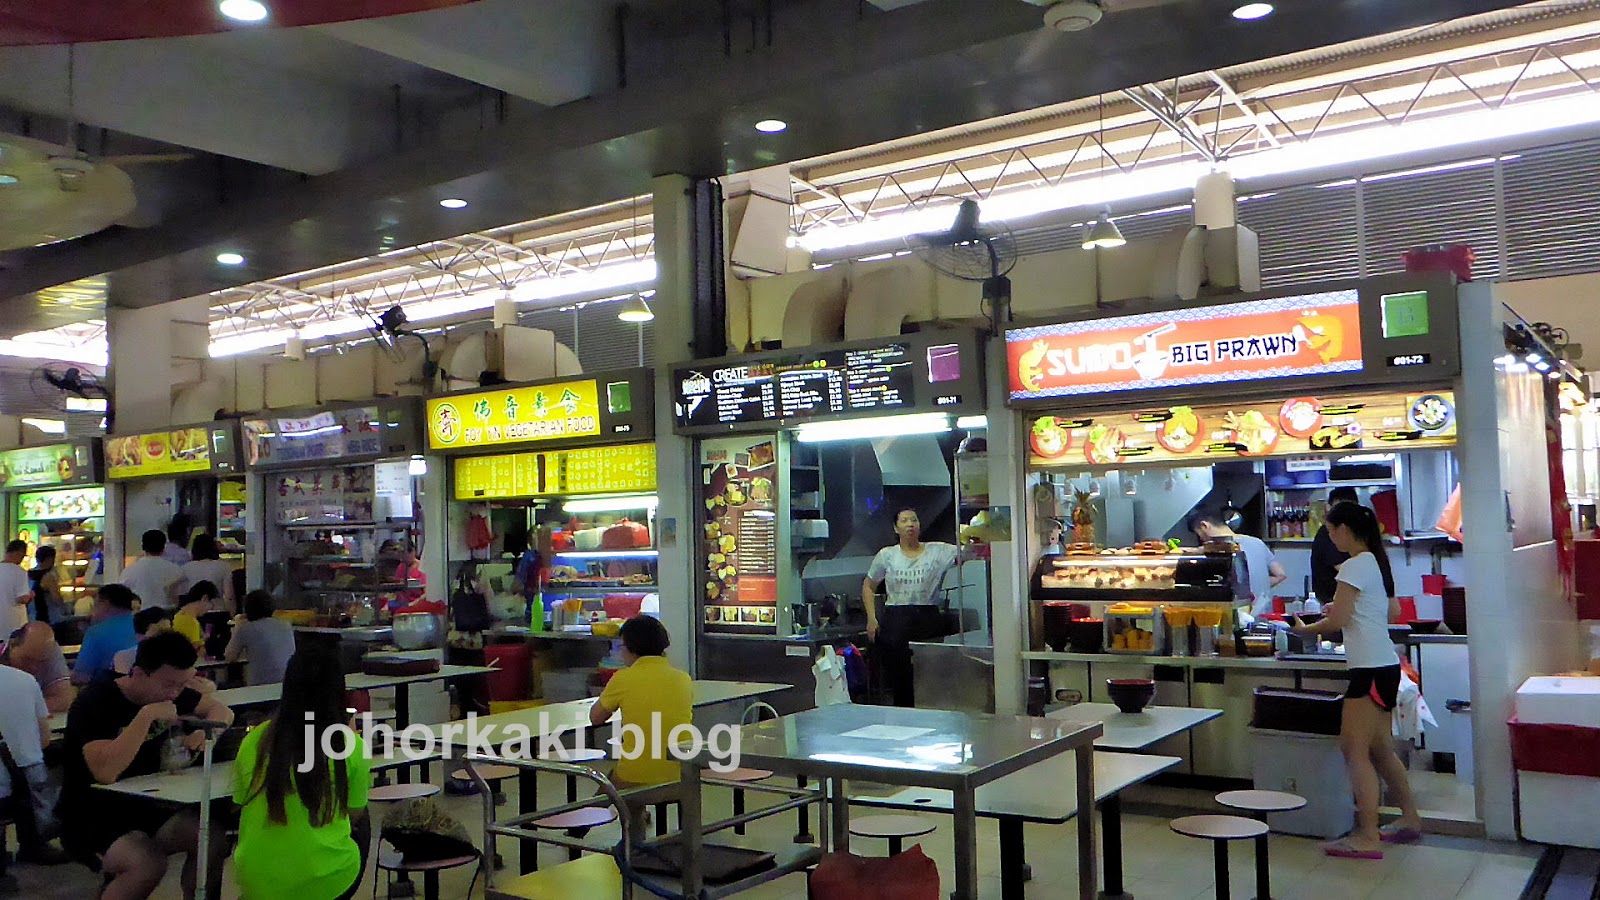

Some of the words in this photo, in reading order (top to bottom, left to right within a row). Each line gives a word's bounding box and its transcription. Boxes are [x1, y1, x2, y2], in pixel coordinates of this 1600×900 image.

[1047, 342, 1132, 376] SUMO
[1170, 341, 1209, 364] BIG
[1217, 334, 1297, 359] PRAWN
[712, 366, 749, 382] CREATE
[505, 419, 565, 440] VEGETARIAN
[567, 415, 595, 432] FOOD
